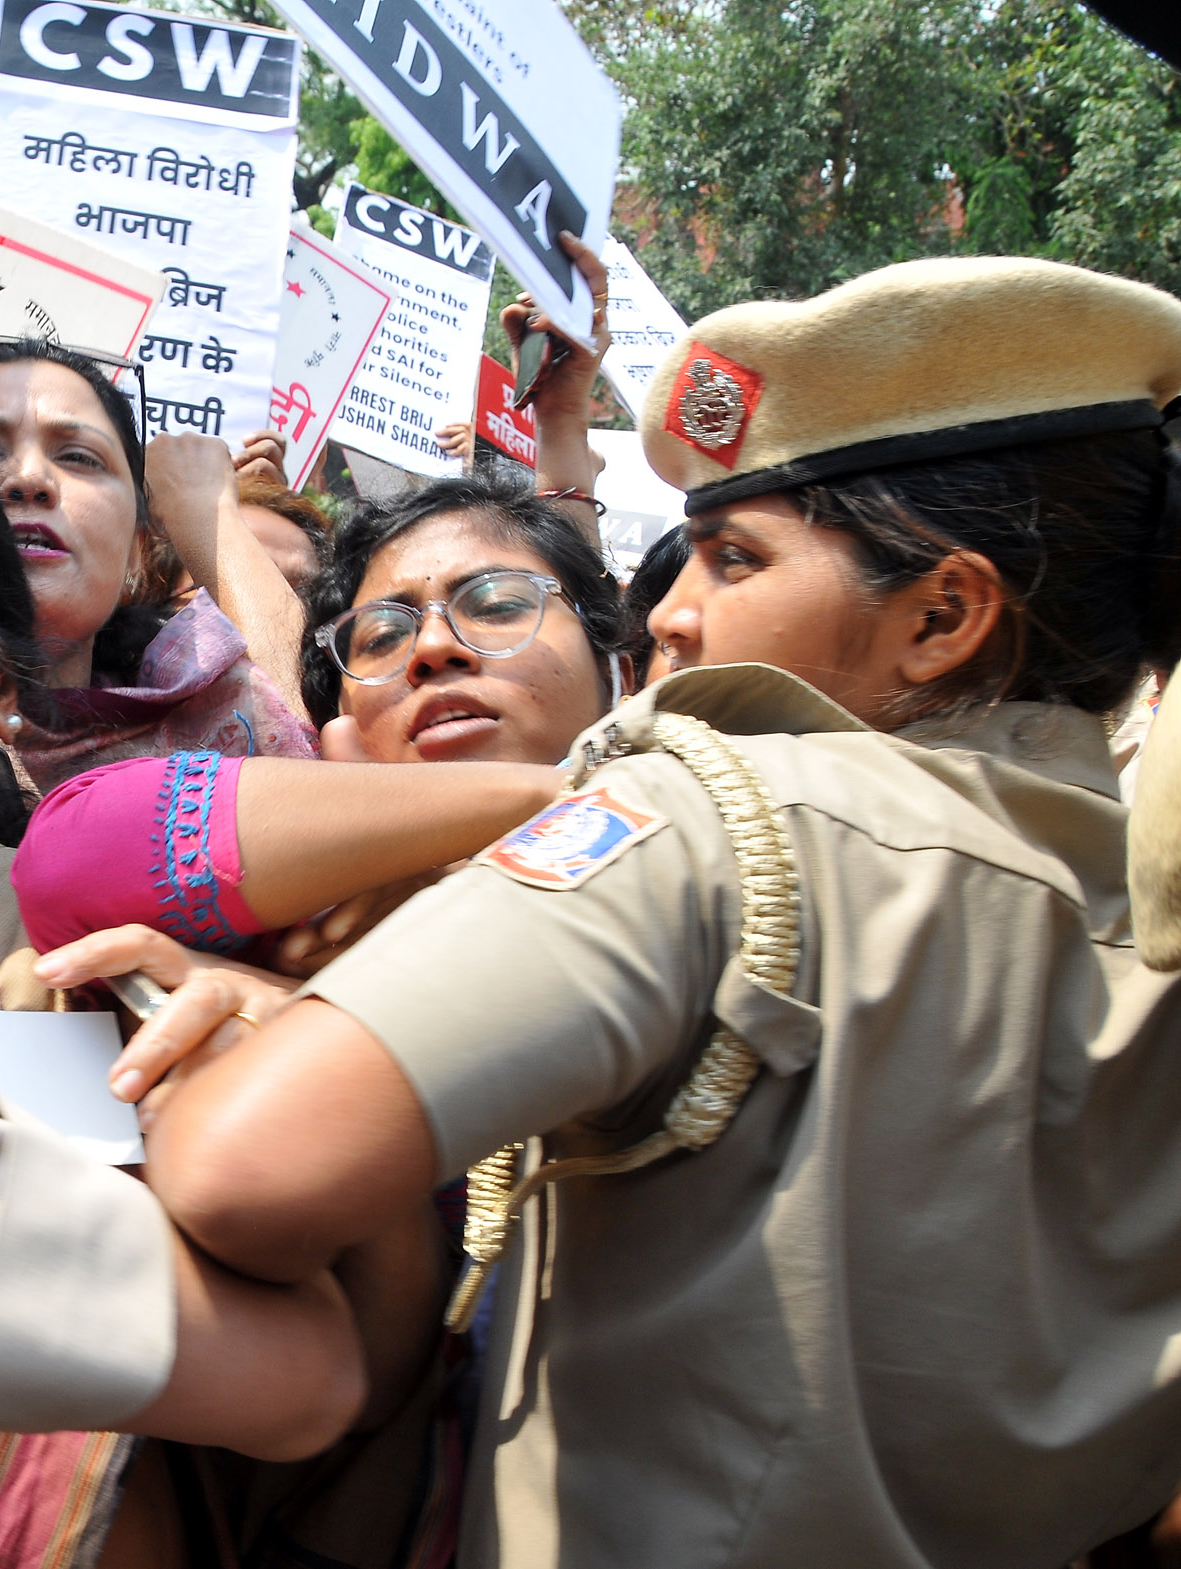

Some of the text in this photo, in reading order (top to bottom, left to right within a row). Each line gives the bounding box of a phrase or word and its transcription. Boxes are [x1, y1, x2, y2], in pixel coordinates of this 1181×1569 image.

[19, 3, 269, 98] CSW
[433, 0, 503, 84] estlers
[331, 0, 552, 251] IDWA
[24, 131, 256, 198] महिला विरोधी
[75, 201, 192, 246] भाजपा
[355, 194, 482, 268] CSW
[415, 284, 436, 299] on
[441, 292, 468, 311] the
[381, 327, 448, 362] horities
[387, 312, 428, 334] olice
[201, 335, 237, 374] के
[387, 349, 414, 369] SAI
[419, 361, 444, 380] for
[380, 366, 451, 404] Silence!
[350, 385, 433, 431] RREST BRIJ
